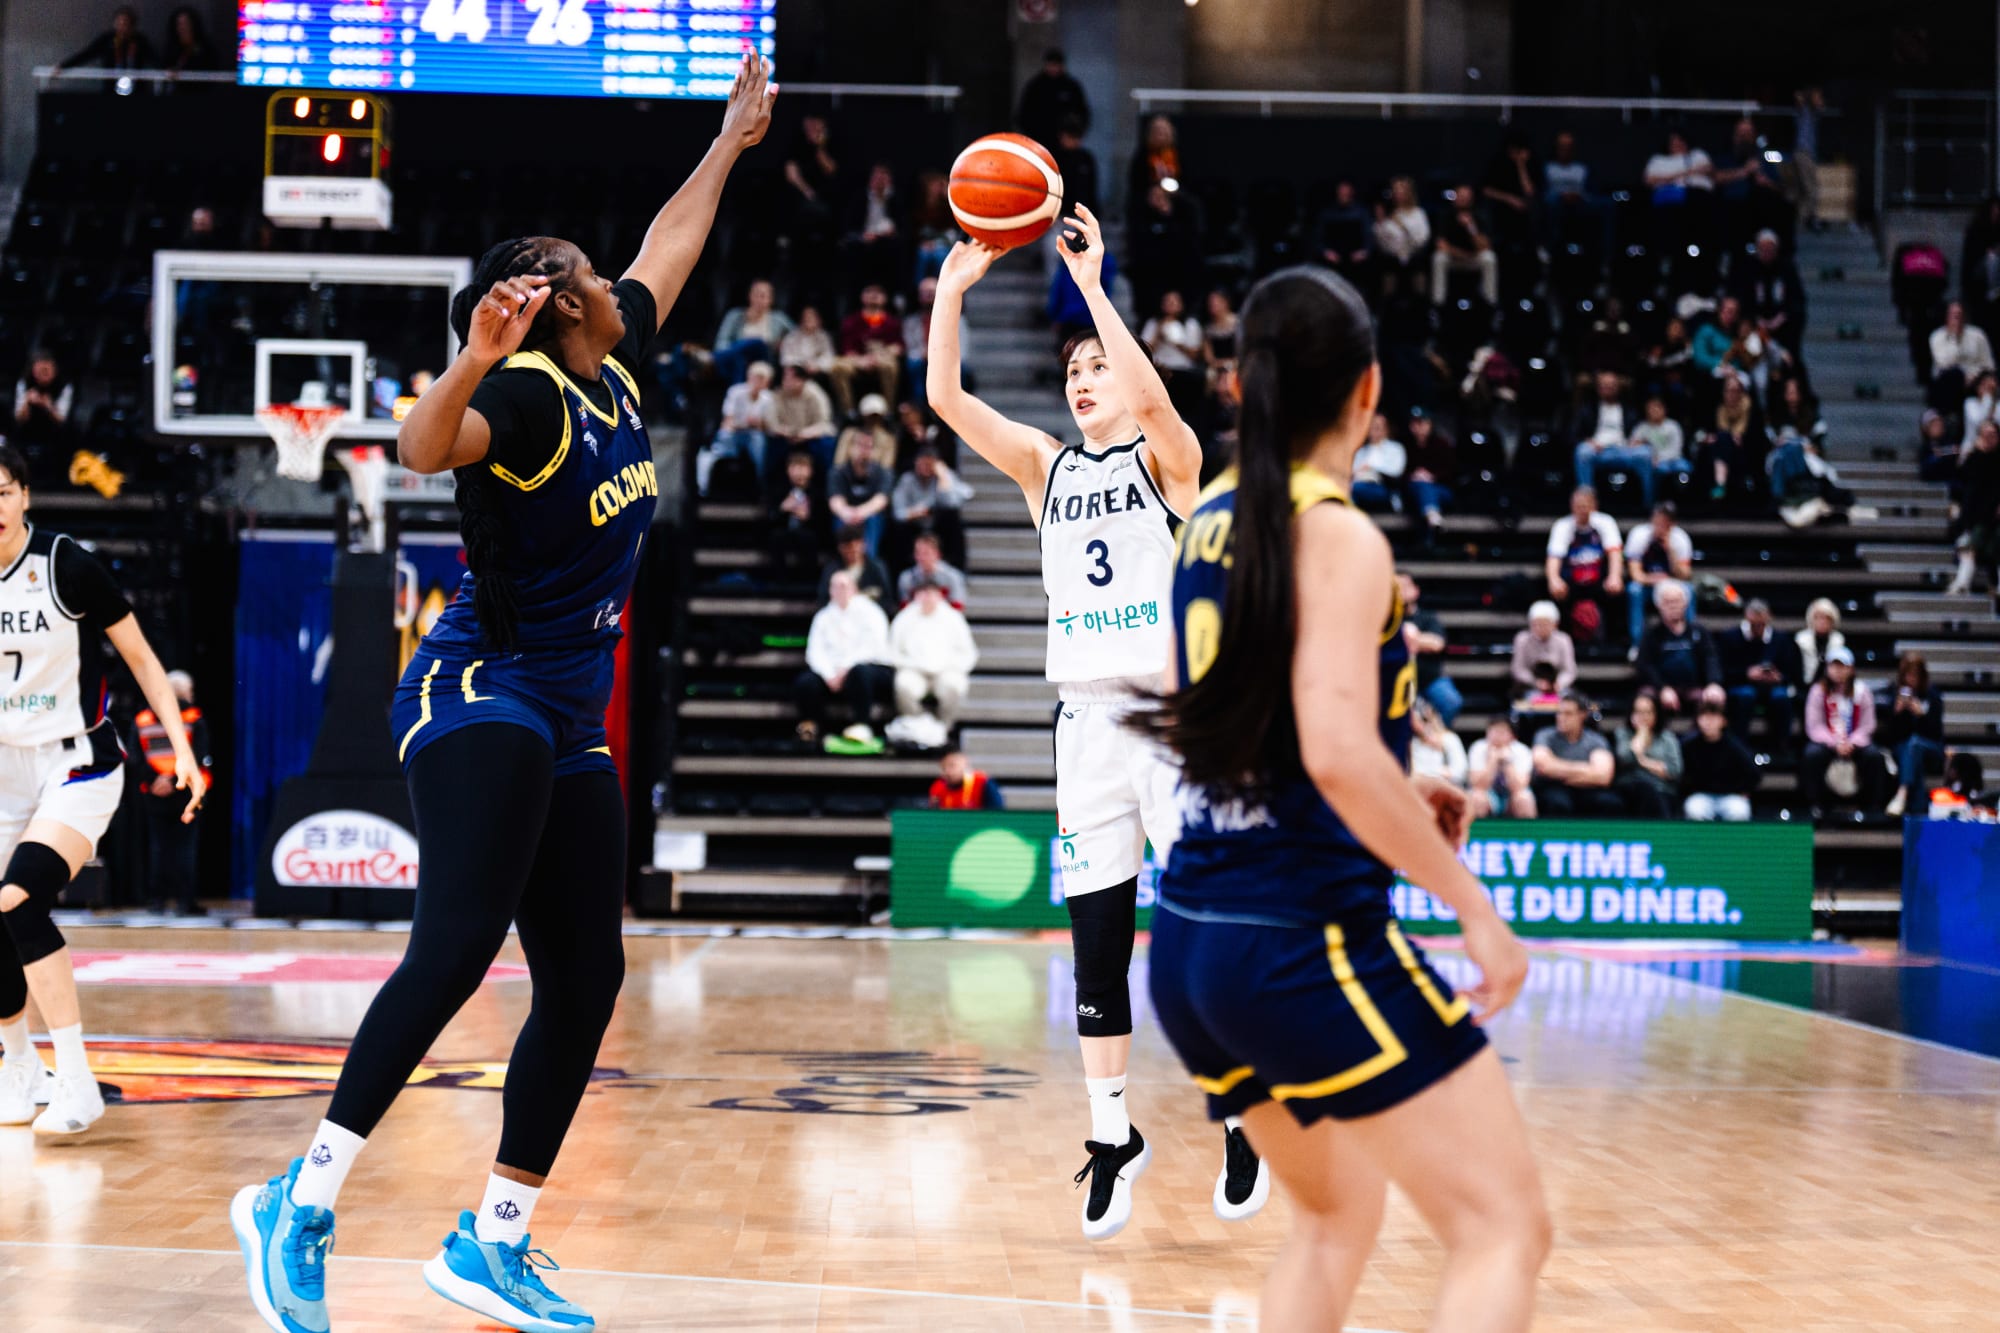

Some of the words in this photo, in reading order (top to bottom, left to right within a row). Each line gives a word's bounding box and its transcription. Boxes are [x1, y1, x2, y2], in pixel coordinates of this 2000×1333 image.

[420, 0, 491, 42] 44
[525, 0, 593, 46] 26
[1050, 482, 1146, 524] KOREA
[1085, 539, 1113, 587] 3
[1083, 600, 1159, 634] 하나은행
[3, 651, 22, 682] 7
[1522, 885, 1585, 922] DU
